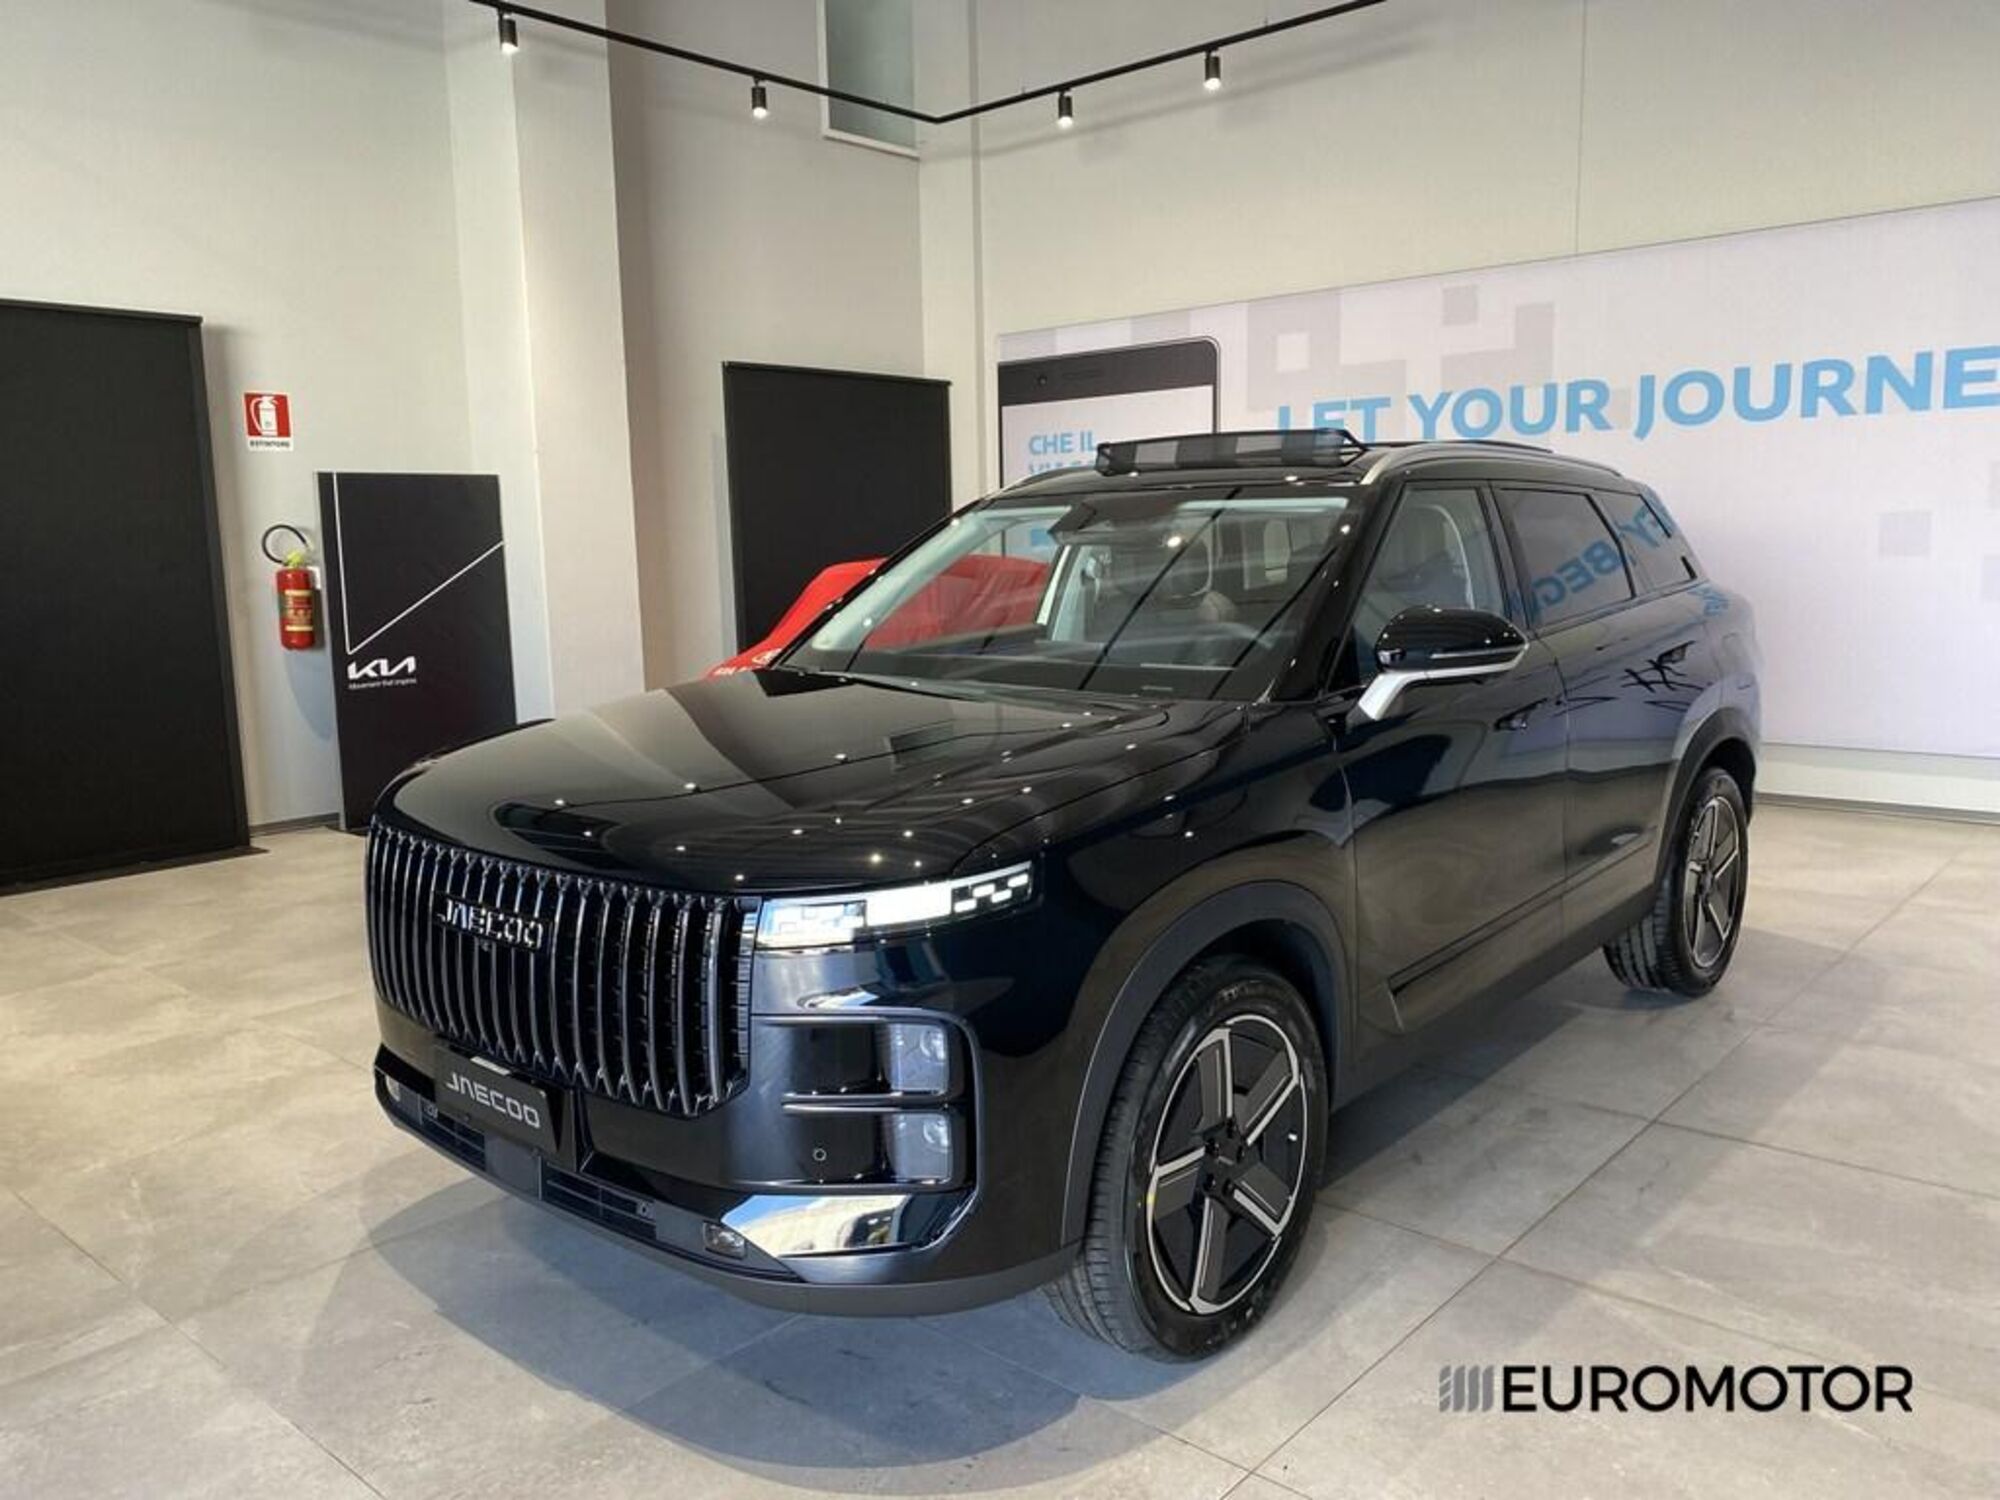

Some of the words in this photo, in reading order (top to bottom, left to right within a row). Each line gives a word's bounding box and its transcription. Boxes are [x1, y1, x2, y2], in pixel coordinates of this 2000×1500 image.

[1406, 380, 1612, 440] YOUR
[1633, 345, 2000, 440] JOURNE
[1028, 433, 1073, 454] CHE
[438, 899, 543, 949] JAECOO
[444, 1071, 542, 1130] JAECOO
